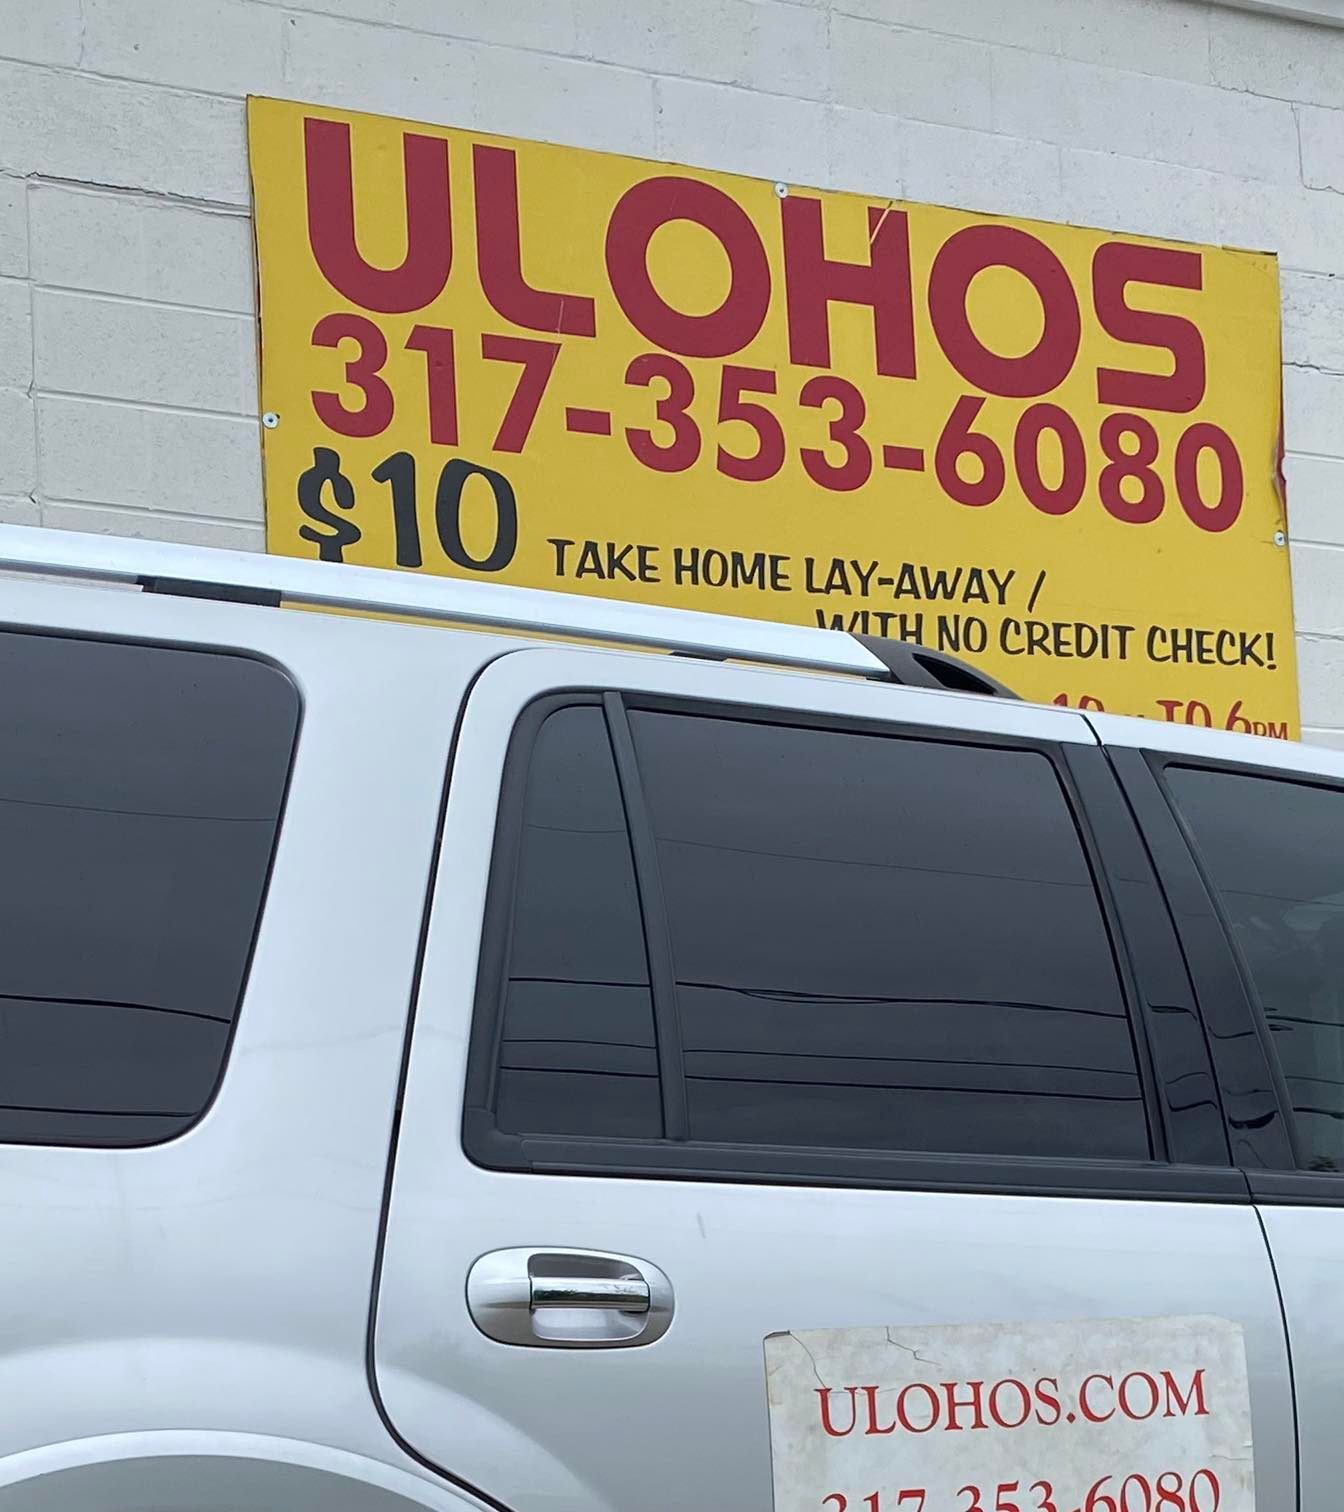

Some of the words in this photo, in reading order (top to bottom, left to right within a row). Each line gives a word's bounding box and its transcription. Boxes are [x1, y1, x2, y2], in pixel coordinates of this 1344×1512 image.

[303, 118, 1206, 413] ULOHOS
[311, 313, 1244, 533] 317-353-6080
[298, 447, 517, 572] $10
[547, 539, 660, 584] TAKE
[674, 547, 791, 591] HOME
[806, 557, 1016, 605] LAY-AWAY
[938, 613, 987, 652] NO
[1000, 616, 1136, 660] CREDIT
[1146, 627, 1278, 670] CHECK!
[814, 1369, 1209, 1437] ULOHOS.COM
